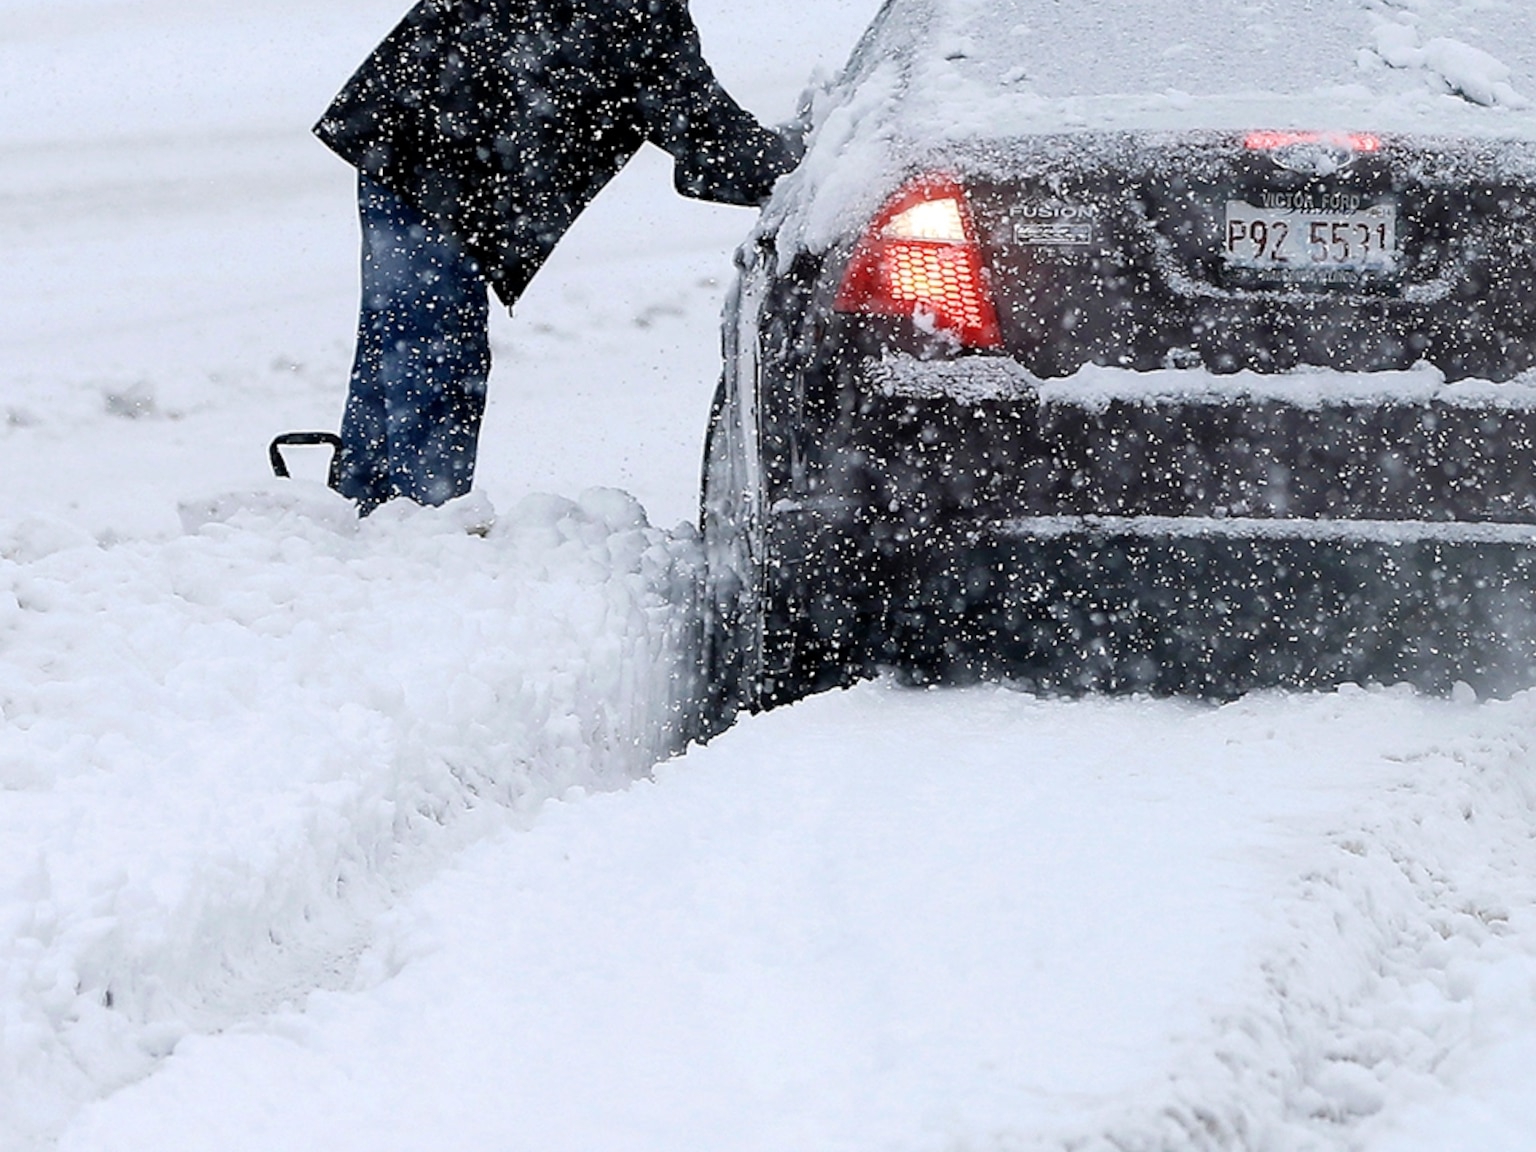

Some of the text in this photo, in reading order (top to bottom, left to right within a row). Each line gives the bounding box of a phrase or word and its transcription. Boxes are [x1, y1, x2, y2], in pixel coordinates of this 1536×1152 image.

[1261, 194, 1361, 210] VICTOR FORD
[1010, 207, 1093, 218] FUSION
[1228, 220, 1386, 264] P92 5531
